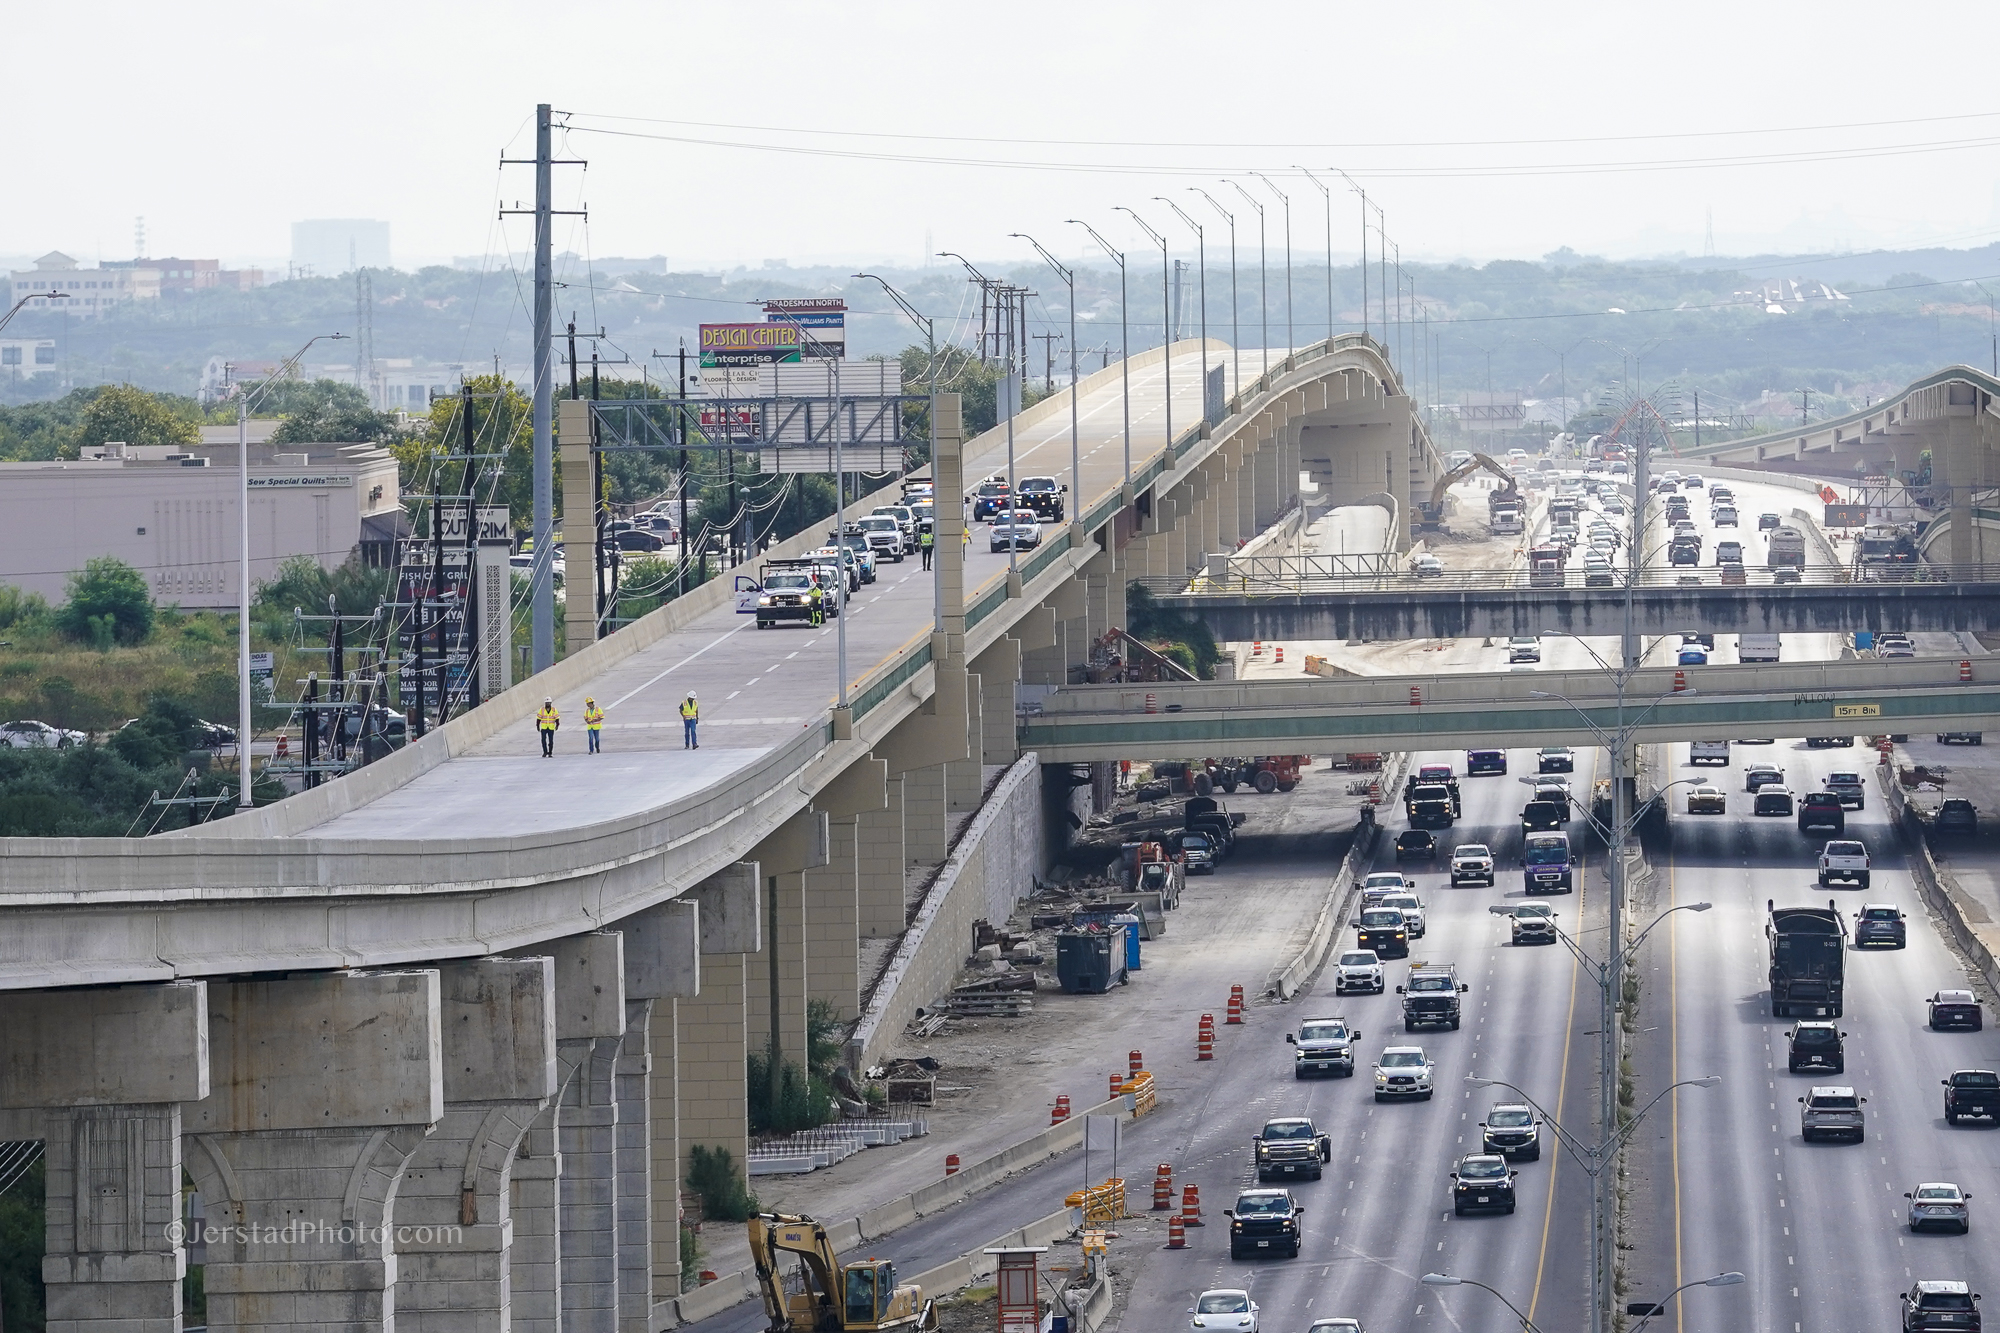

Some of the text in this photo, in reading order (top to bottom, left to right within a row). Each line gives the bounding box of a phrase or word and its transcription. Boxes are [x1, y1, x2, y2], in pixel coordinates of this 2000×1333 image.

[769, 298, 842, 307] TRADESMAN NORTH
[703, 328, 797, 346] DESIGN CENTER
[267, 477, 300, 486] Special
[301, 477, 326, 485] Quilts
[480, 521, 508, 539] RIM
[400, 572, 421, 580] FISH
[1839, 706, 1876, 715] 15FT 8IN
